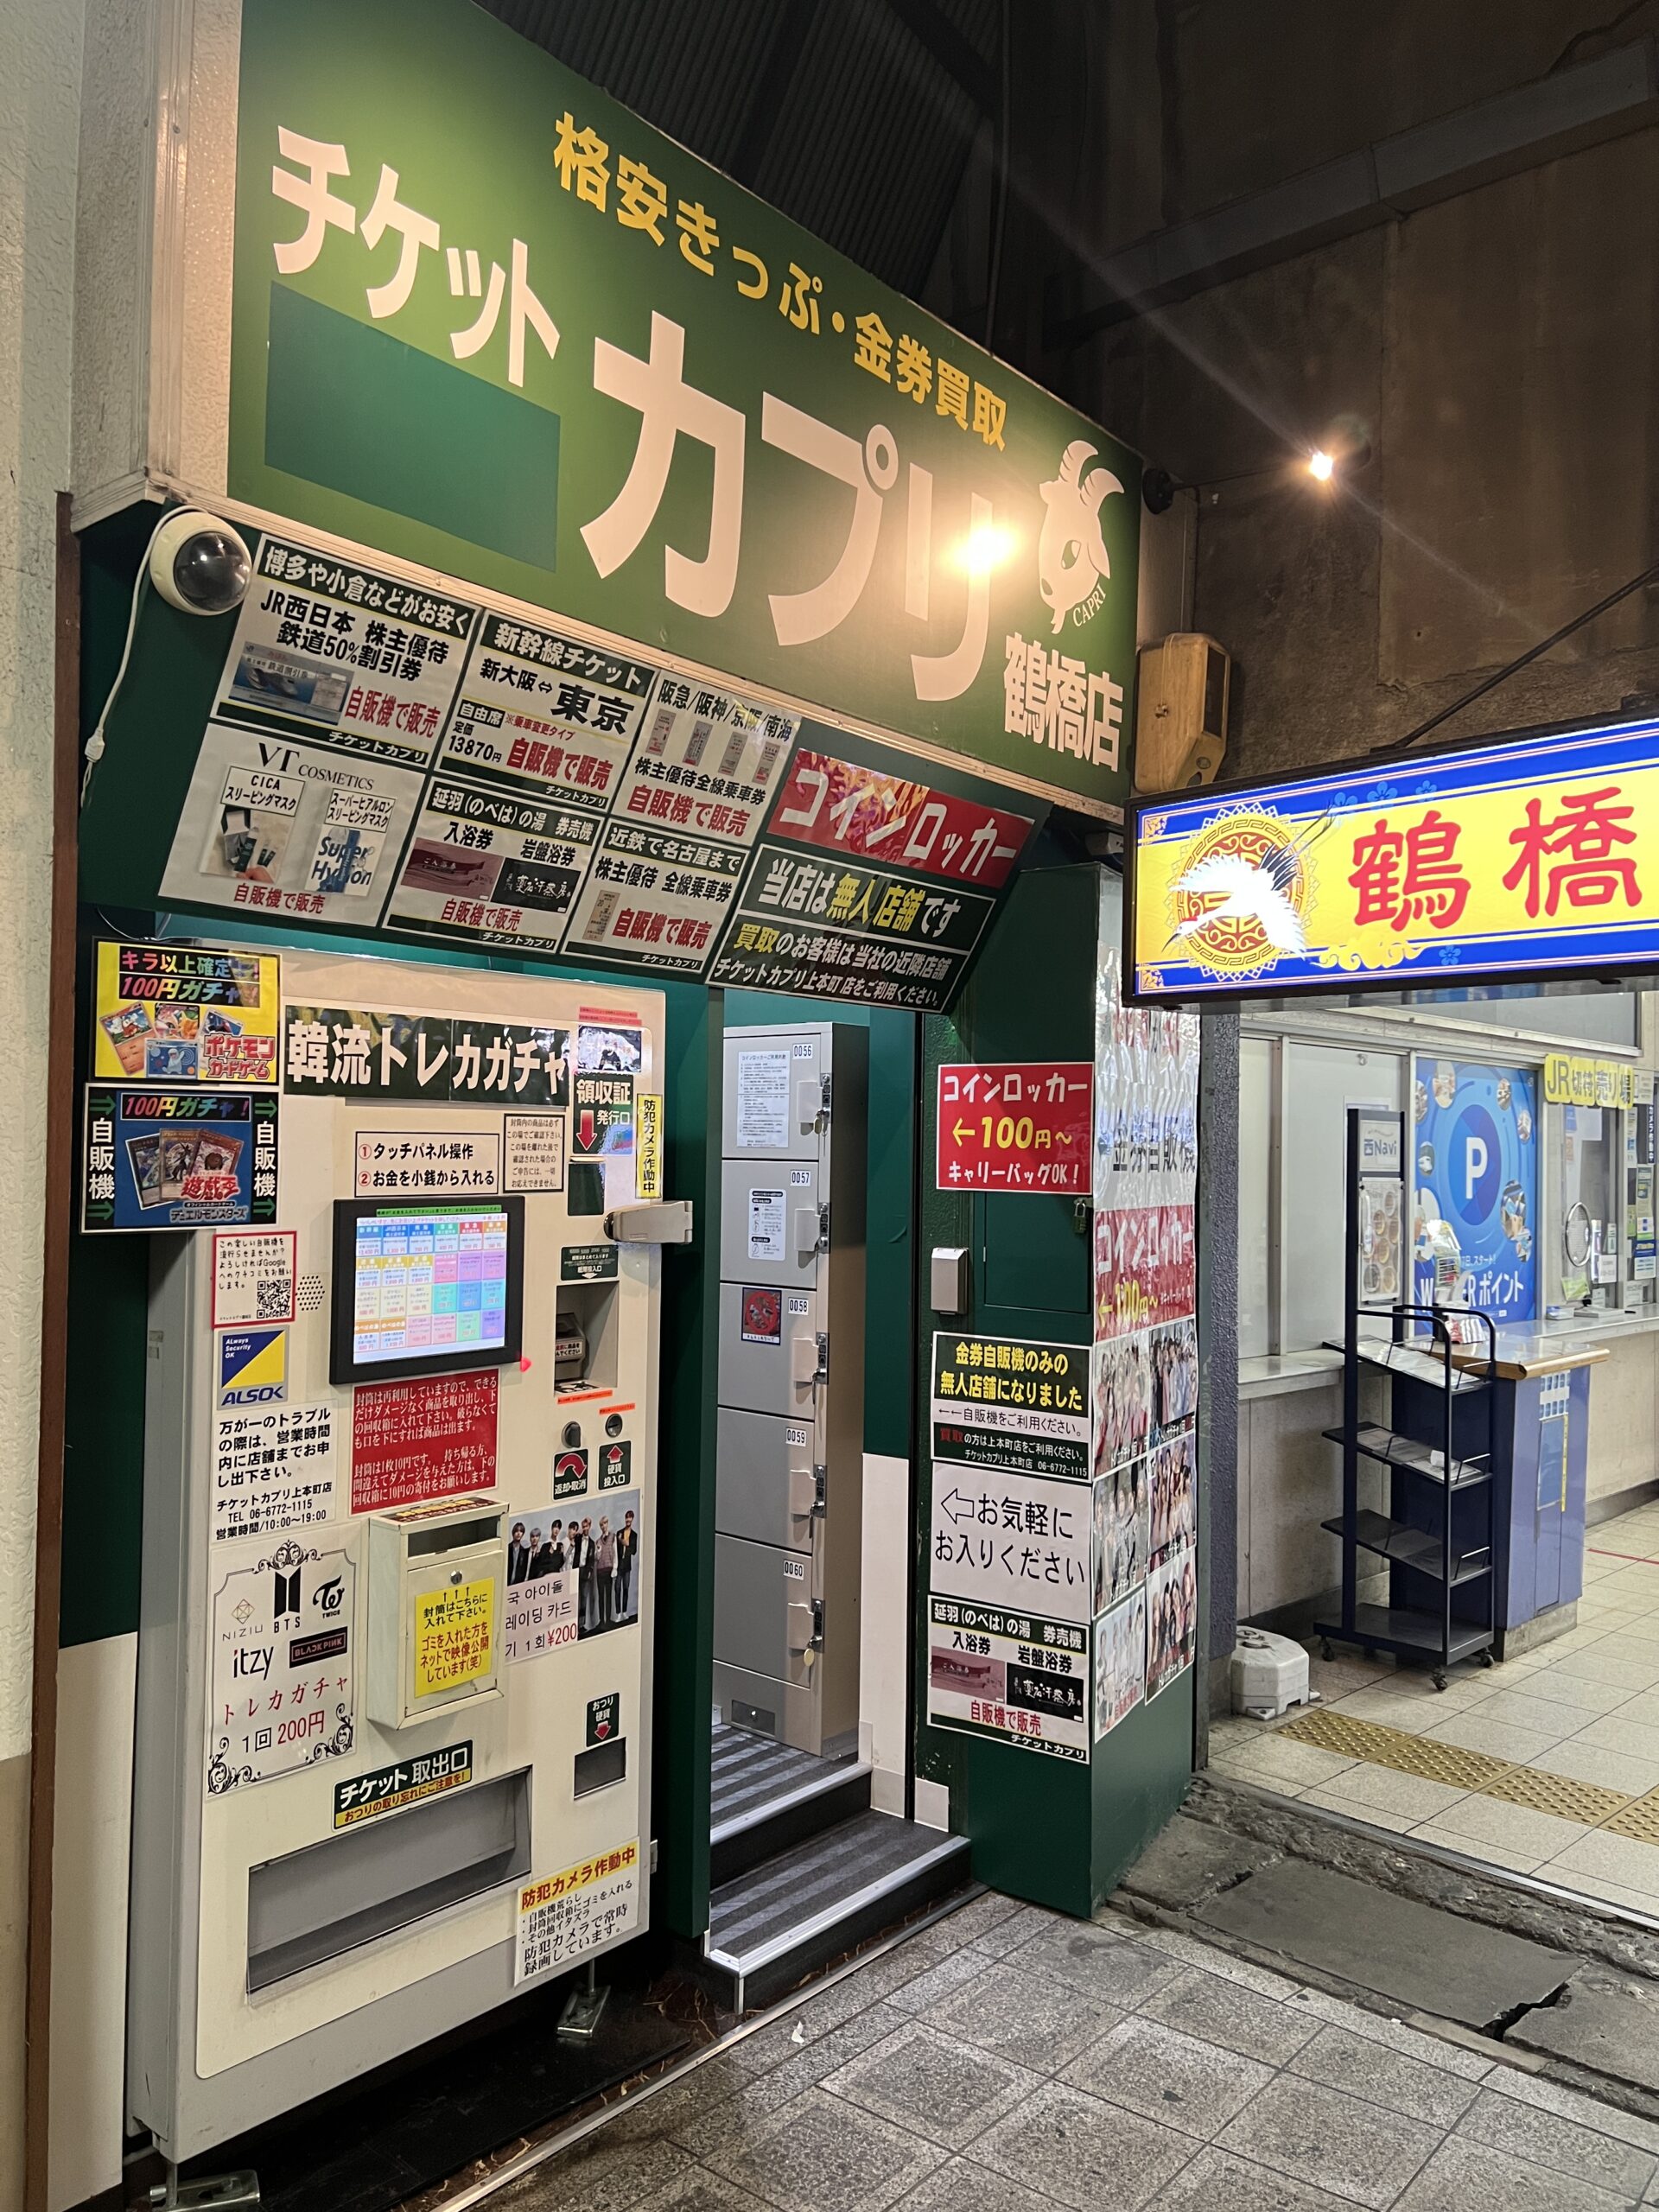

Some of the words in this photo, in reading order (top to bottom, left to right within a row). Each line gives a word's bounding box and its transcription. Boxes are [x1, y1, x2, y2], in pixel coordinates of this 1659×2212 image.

[271, 125, 560, 386] チケット
[554, 112, 1008, 451] 格安きっぷ・金券買取
[580, 310, 993, 702] カプリ
[264, 546, 469, 635] 博多や小倉などがお安く
[1071, 584, 1108, 627] CAPRI
[260, 589, 356, 635] JR西日本
[365, 620, 449, 664] 株主優待
[276, 620, 423, 681] 鉄道50%割引券
[494, 623, 641, 689] 新幹線チケット
[344, 685, 442, 738] 自販機で販売
[480, 658, 537, 692] 新大阪
[550, 683, 635, 734] 東京
[657, 679, 793, 742] 阪急/阪神/京阪/南海
[1003, 632, 1124, 772] 鶴橋店
[453, 721, 474, 735] 定価
[460, 703, 504, 725] 自由席
[329, 732, 425, 761] チケットカプリ
[448, 735, 502, 762] 13870円
[258, 742, 300, 772] VT
[298, 764, 374, 791] COSMETICS
[506, 738, 613, 791] 自販機で販売
[634, 756, 766, 805] 株主優待全線乗車券
[226, 787, 296, 810] スリーピングマスク
[251, 775, 280, 791] CICA
[546, 785, 605, 808] チケットカプリ
[327, 808, 389, 828] スリーピングマスク
[331, 792, 393, 813] スーパーヒアルロン
[432, 787, 547, 831] 延羽(のべは)の湯
[556, 817, 594, 842] 券売機
[627, 785, 751, 837] 自販機で販売
[779, 768, 1017, 876] コインロッカー
[443, 822, 493, 849] 入浴券
[520, 839, 576, 867] 岩盤浴券
[608, 827, 741, 872] 近鉄で名古屋まで
[1348, 786, 1643, 931] 鶴橋
[594, 856, 658, 888] 株主優待
[662, 872, 732, 903] 全線乗車券
[233, 883, 326, 914] 自販機で販売
[759, 858, 962, 938] 当店は無人店舗です
[441, 899, 523, 931] 自販機で販売
[612, 908, 712, 950] 自販機で販売
[482, 932, 554, 949] チケットカプリ
[734, 924, 952, 982] 買取のお客様は当社の近隣店舗
[642, 955, 698, 969] チケットカプリ
[714, 958, 940, 1007] チケットカプリ上本町店をご利用ください。
[205, 1033, 275, 1060] ポケモン
[288, 1020, 567, 1095] 韓流トレカガチャ
[794, 1046, 812, 1056] 0056
[207, 1058, 270, 1079] カードゲーム
[576, 1079, 632, 1105] 領収証
[944, 1072, 1088, 1103] コインロッカー
[596, 1109, 631, 1126] 発行口
[89, 1118, 115, 1199] 自販機
[254, 1122, 276, 1197] 自販機
[643, 1099, 657, 1193] 防犯カメラ作動中
[791, 1172, 810, 1184] 0057
[1465, 1136, 1488, 1199] P
[181, 1175, 240, 1201] 遊戯王
[170, 1208, 247, 1222] デュエルモンスターズ
[219, 1237, 284, 1249] この楽しい自販機を
[789, 1300, 808, 1313] 0058
[225, 1344, 251, 1352] Security
[956, 1341, 1069, 1376] 金券自販機のみの
[221, 1386, 283, 1406] ALSOK
[355, 1389, 496, 1421] だけダメージなく商品を取り出し、下
[356, 1376, 497, 1408] 封筒は再利用していますので、できる
[940, 1371, 1083, 1411] 無人店舗になりました
[219, 1408, 331, 1435] 万が一のトラブル
[354, 1420, 475, 1449] も口を下にすれば商品は出ます。
[787, 1430, 805, 1443] 0059
[963, 1408, 1081, 1437] 自販機をご利用ください。
[219, 1424, 330, 1452] の際は、営業時間
[940, 1427, 1084, 1461] 買取の方は上本町店をご利用ください。
[219, 1441, 329, 1471] 内に店舗までお申
[965, 1449, 1033, 1469] チケットカプリ上本町店
[1038, 1462, 1087, 1477] 06-6772-1115
[218, 1466, 292, 1489] し出下さい。
[604, 1474, 626, 1487] 投入口
[217, 1482, 333, 1512] チケットカプリ上本町店
[228, 1512, 244, 1523] TEL
[250, 1499, 313, 1520] 06-6772-1115
[977, 1493, 1073, 1539] お気軽に
[785, 1561, 803, 1577] 0060
[935, 1530, 1085, 1586] お入りください
[524, 1580, 563, 1599] 아이돌
[322, 1610, 340, 1618] TWICE
[423, 1593, 487, 1619] 封筒はこちらに
[424, 1607, 486, 1630] 入れて下さい。
[505, 1607, 543, 1630] 레이딩
[548, 1601, 572, 1618] 카드
[274, 1616, 301, 1634] BTS
[422, 1621, 487, 1652] ゴミを入れた方を
[548, 1623, 577, 1647] ¥200
[934, 1603, 1031, 1638] 延羽(のべは)の湯
[1043, 1624, 1082, 1649] 券売機
[233, 1646, 274, 1681] itzy
[421, 1635, 489, 1669] ネットで映像公開
[952, 1631, 991, 1655] 入浴券
[1018, 1645, 1072, 1674] 岩盤浴券
[225, 1677, 348, 1726] トレカガチャ
[593, 1696, 613, 1711] おつり
[277, 1710, 325, 1744] 200円
[971, 1700, 1041, 1737] 自販機で販売
[1011, 1734, 1084, 1759] チケットカプリ
[340, 1747, 467, 1809] チケット取出口
[522, 1847, 635, 1910] 防犯カメラ作動中
[524, 1903, 627, 1962] 防犯カメラで常時
[524, 1923, 621, 1976] 録画しています。
